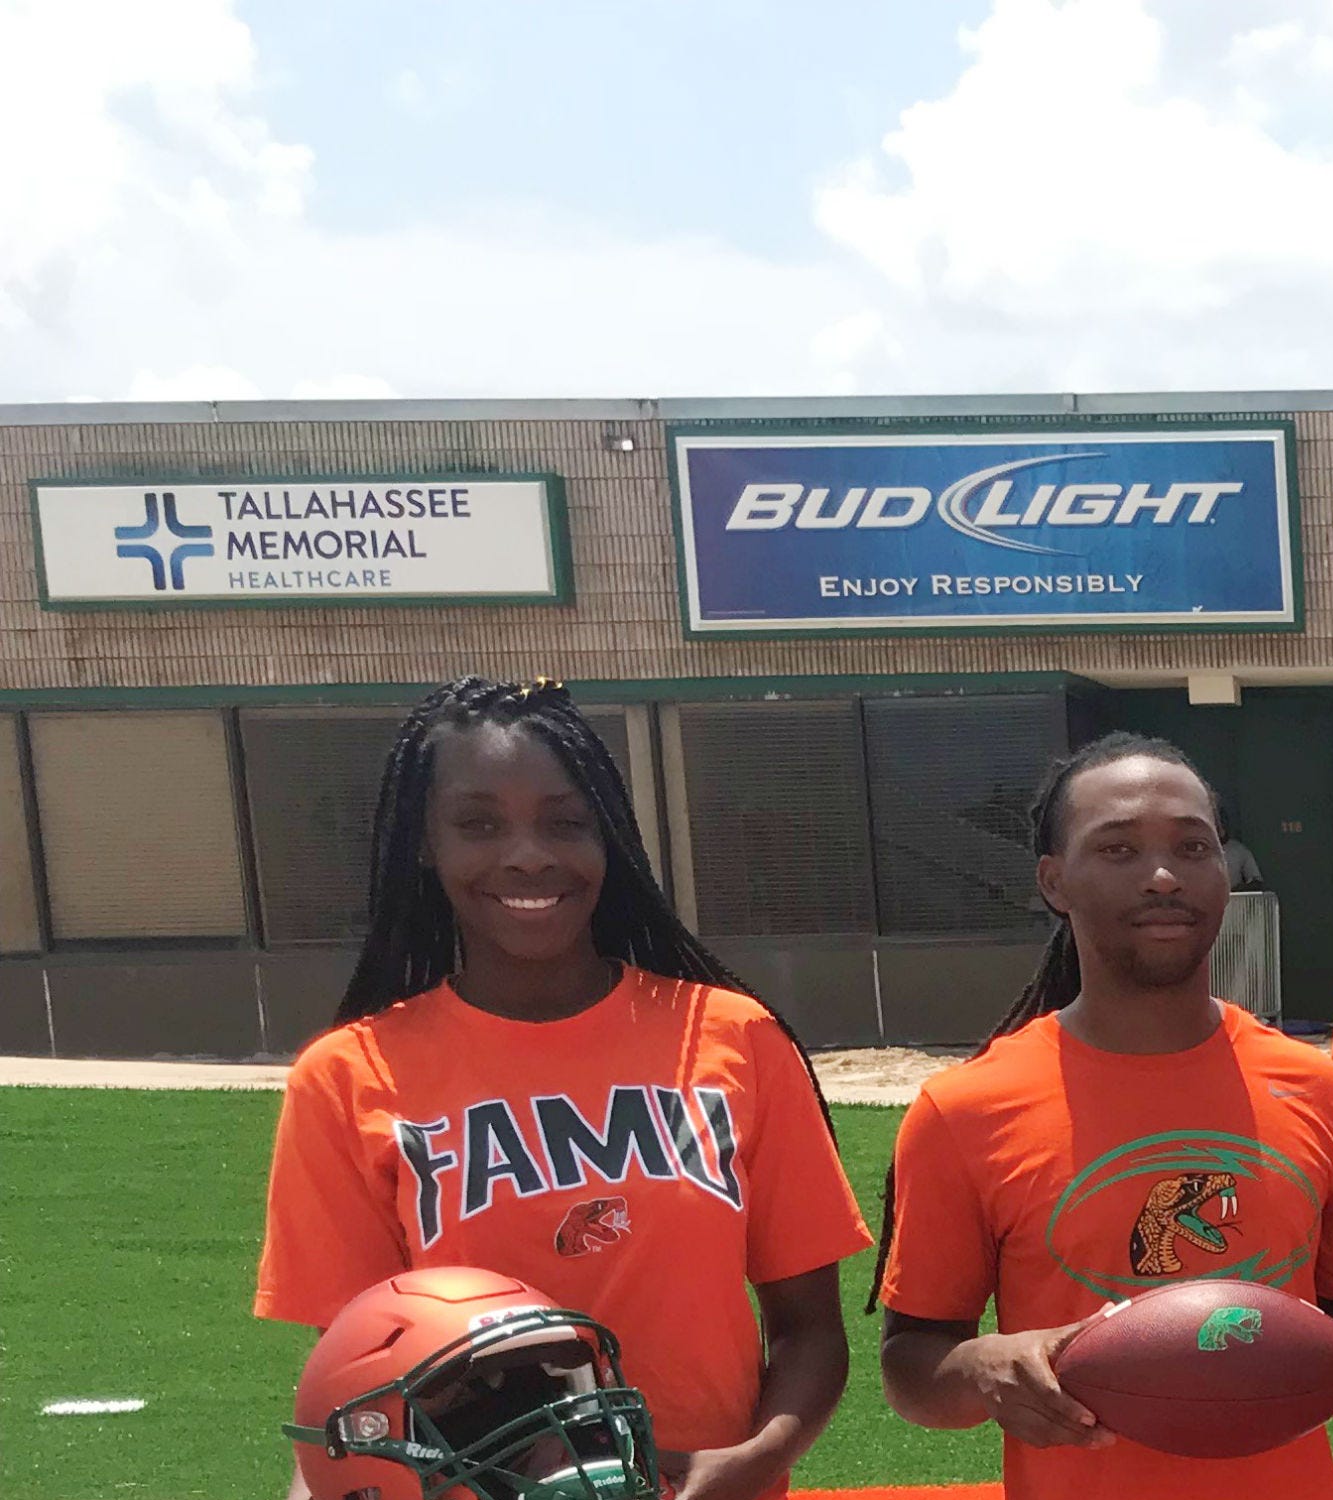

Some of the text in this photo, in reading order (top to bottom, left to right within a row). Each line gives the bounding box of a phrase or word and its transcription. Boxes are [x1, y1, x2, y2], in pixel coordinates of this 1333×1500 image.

[218, 489, 471, 520] TALLAHASSEE
[725, 481, 1244, 530] BUD LIGHT
[227, 530, 427, 560] MEMORIAL
[229, 569, 392, 588] HEALTHCARE
[819, 574, 1143, 597] ENJOY RESPONSIBLY
[393, 1084, 744, 1250] FAMU
